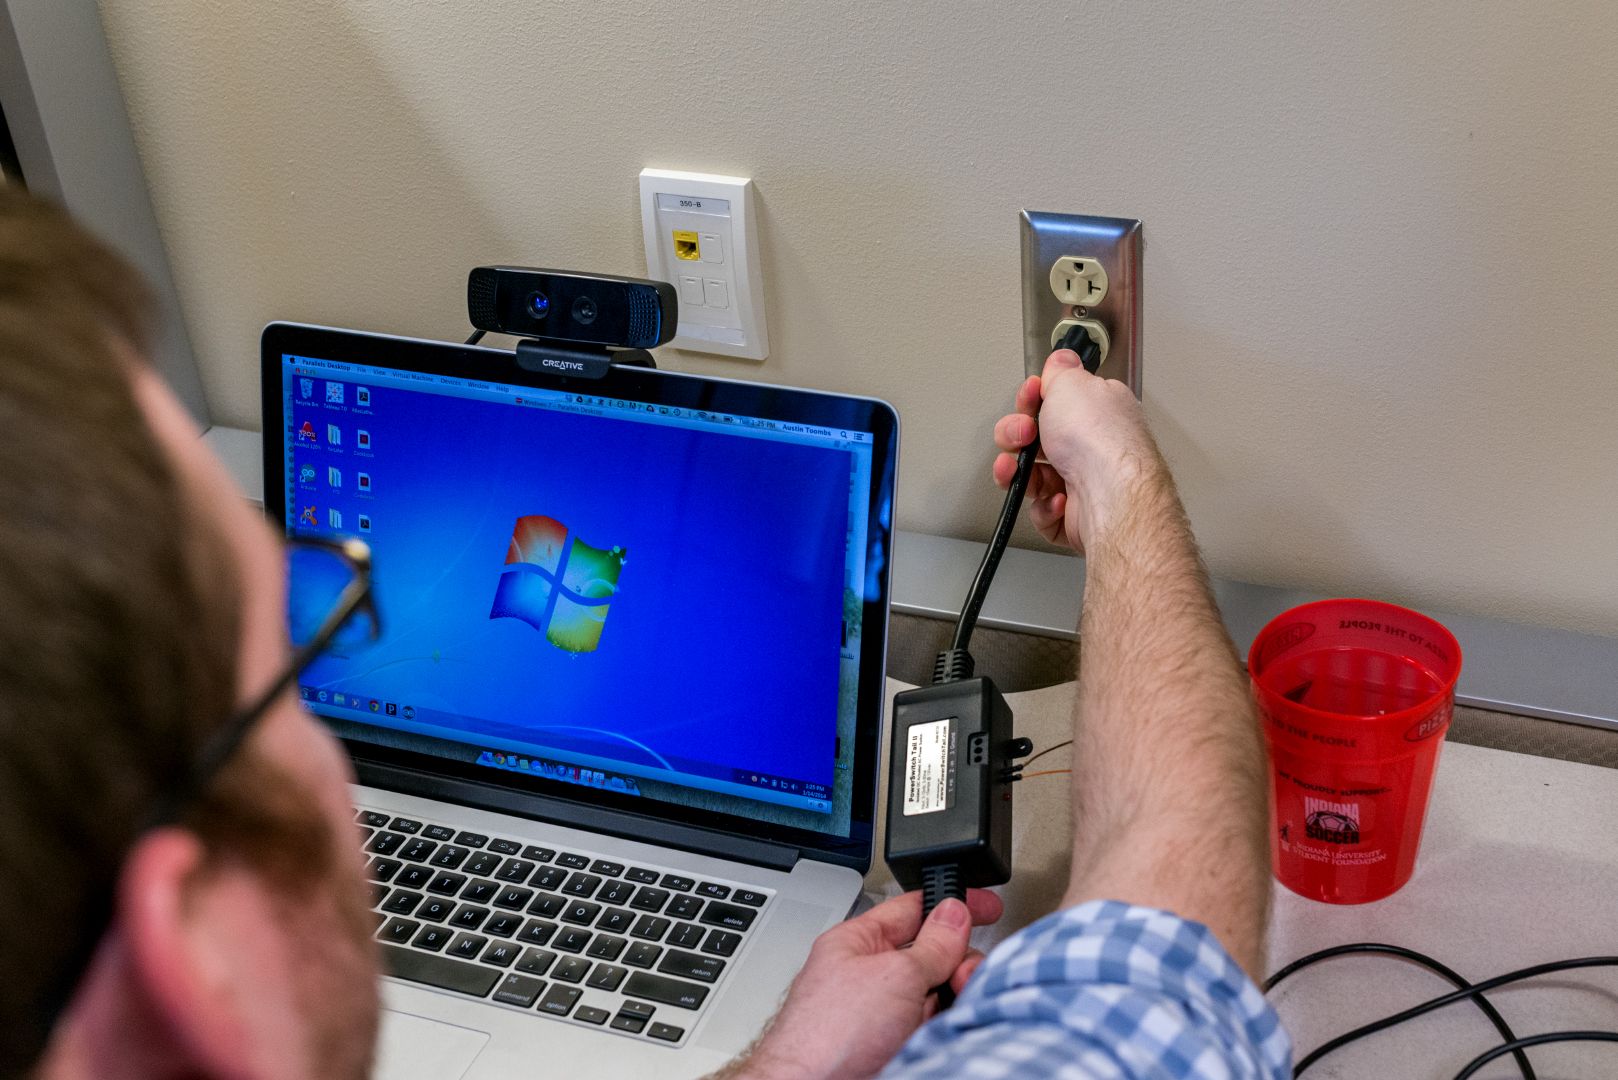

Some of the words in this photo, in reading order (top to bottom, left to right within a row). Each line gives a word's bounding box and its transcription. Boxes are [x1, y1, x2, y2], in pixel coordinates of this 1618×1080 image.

[680, 200, 702, 208] 350-B
[542, 359, 583, 370] CREATIVE
[303, 360, 326, 368] Parallels
[328, 363, 351, 371] Desktop
[412, 374, 434, 382] Machine
[440, 378, 461, 386] Devices
[468, 382, 490, 390] Window
[782, 424, 804, 433] Austin
[805, 427, 832, 436] Toombs
[1312, 734, 1357, 748] PEOPLE
[909, 756, 917, 803] PowerSwitch
[1305, 796, 1360, 825] INDIANA
[1306, 823, 1360, 844] SOCCER
